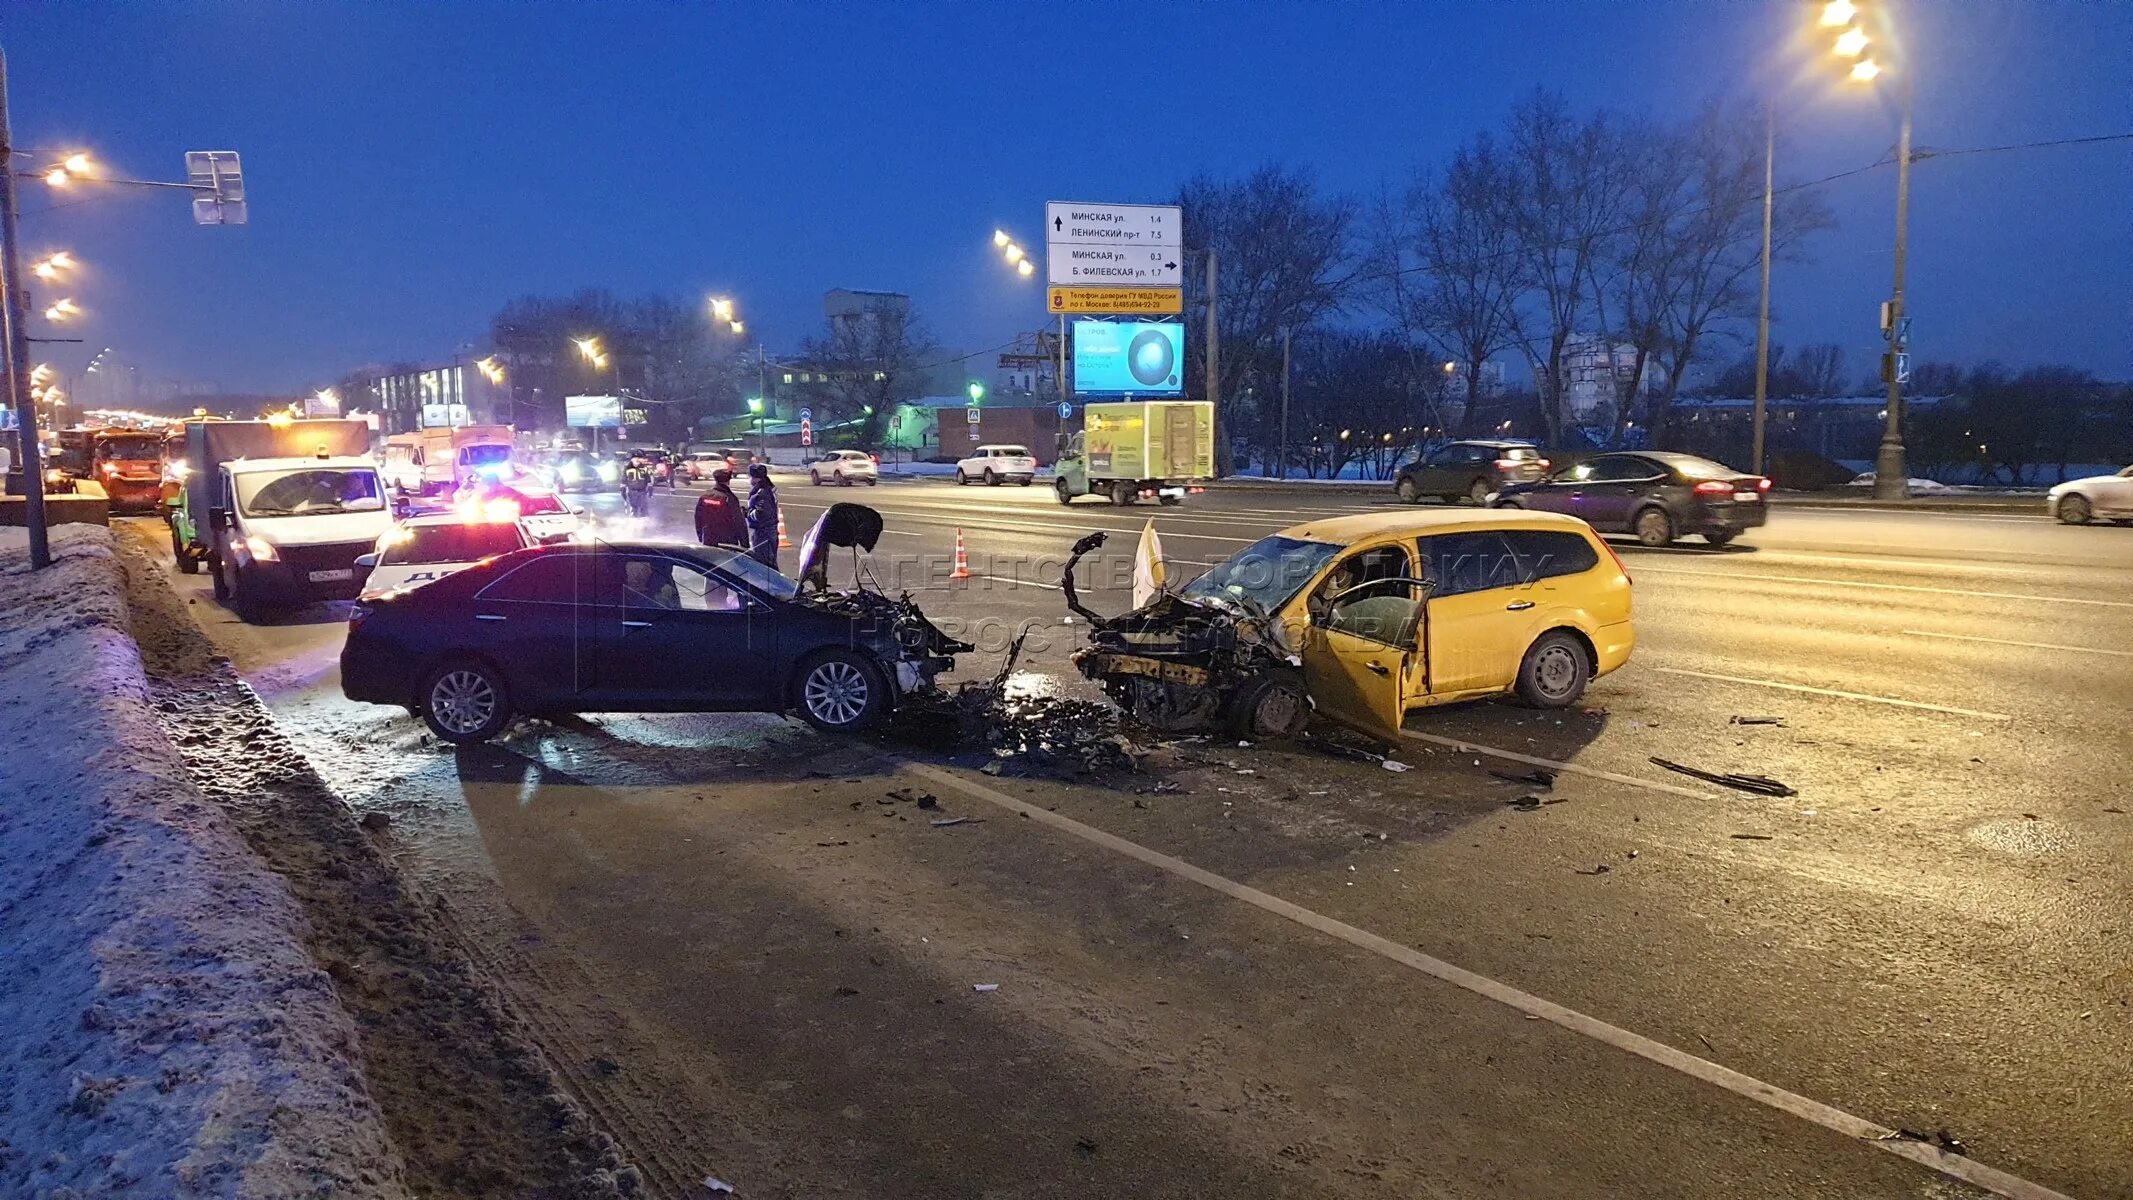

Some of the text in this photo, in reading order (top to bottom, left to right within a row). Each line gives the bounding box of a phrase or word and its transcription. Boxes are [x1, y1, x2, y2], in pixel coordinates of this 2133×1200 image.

[1071, 212, 1161, 223] МИНСКАЯ ул. 1.4
[1071, 228, 1162, 240] ЛЕНИНСКИЙ пр-т 7.5
[1072, 251, 1162, 261] МИНСКАЯ ул. 0.3
[1072, 267, 1162, 277] Б. ФИЛЕВСКАЯ ул. 1.7
[1070, 291, 1099, 300] Телефон
[1099, 292, 1127, 300] доверия
[1139, 292, 1153, 300] МВД
